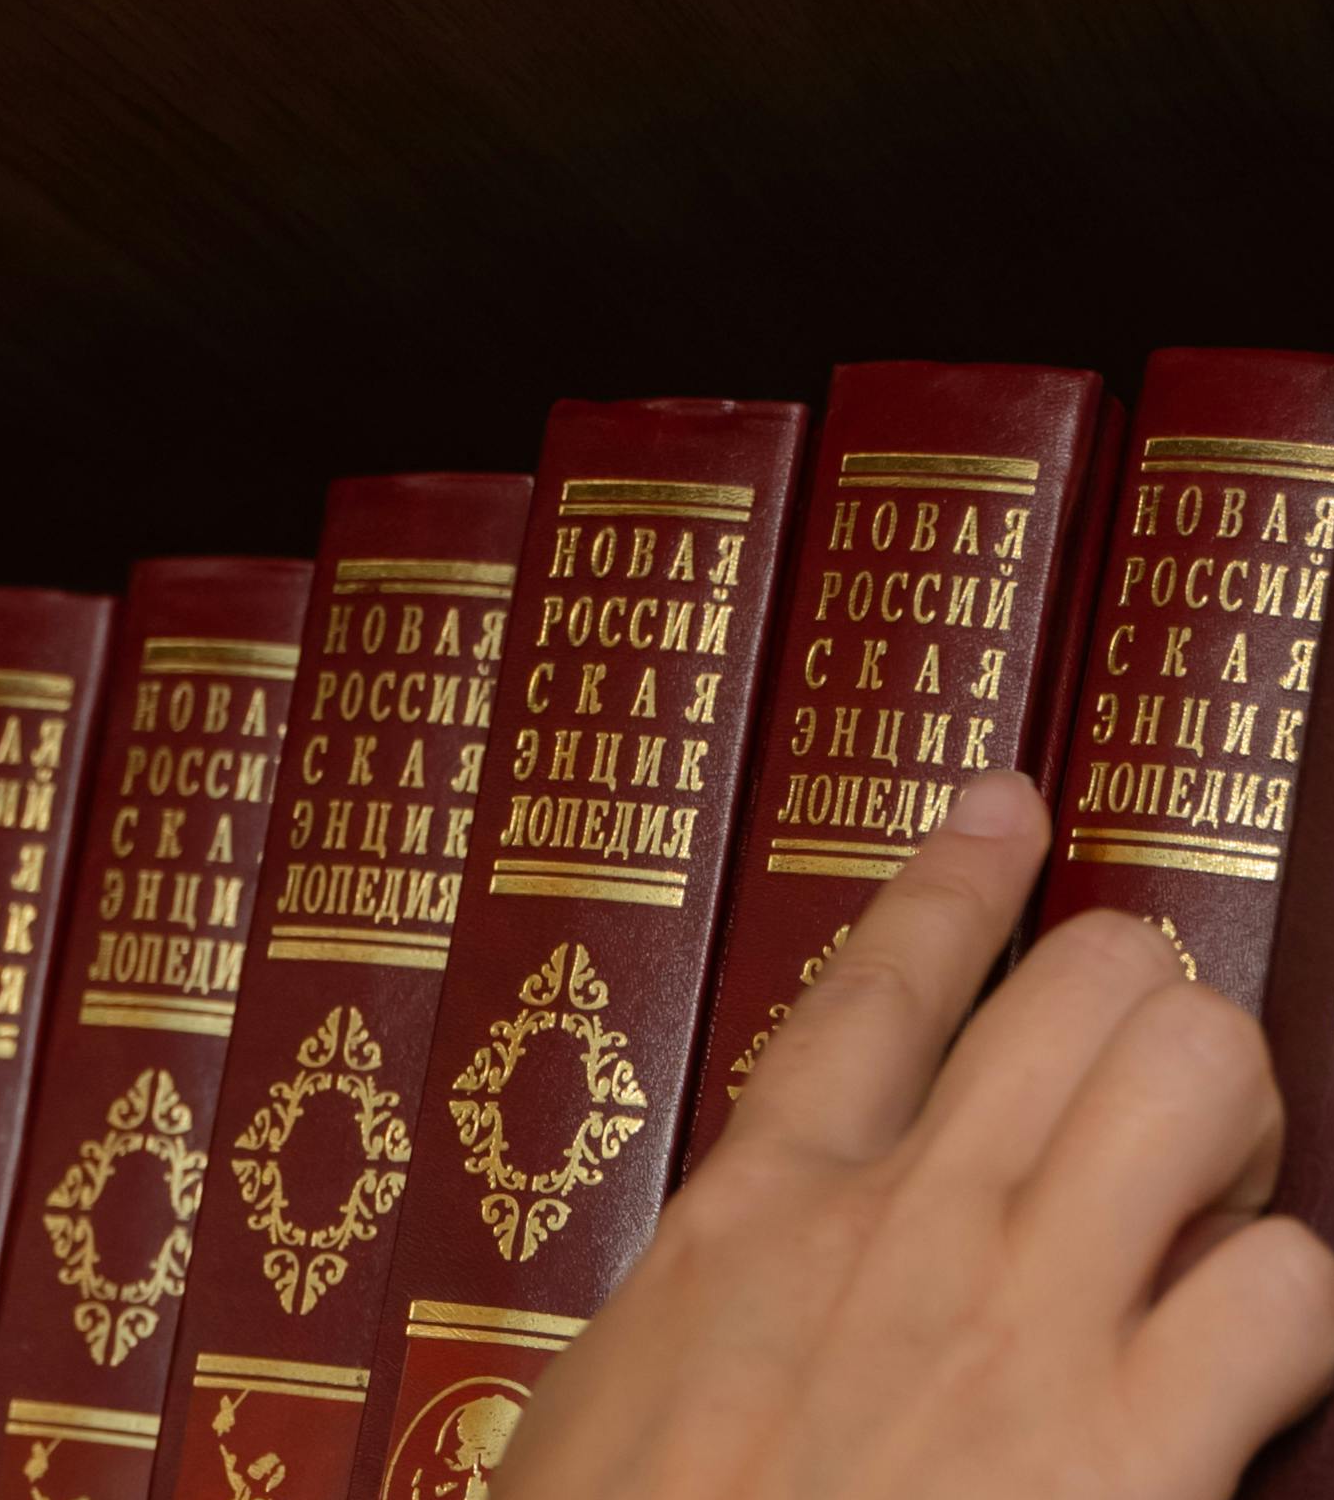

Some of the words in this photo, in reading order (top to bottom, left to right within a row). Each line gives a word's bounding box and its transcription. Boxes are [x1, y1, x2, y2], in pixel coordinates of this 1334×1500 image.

[548, 525, 745, 587] НОВАЯ
[829, 500, 1031, 561] НОВАЯ
[815, 565, 1019, 631] РОССИЙ
[1118, 552, 1329, 622] РОССИЙ
[323, 605, 507, 663] НОВАЯ
[536, 587, 733, 656] РОССИЙ
[805, 637, 1007, 701] СКАЯ
[1106, 625, 1317, 693] СКАЯ
[311, 663, 493, 729] РОССИЙ
[526, 662, 722, 725] СКАЯ
[791, 706, 994, 771] ЭНЦИК
[1092, 693, 1305, 764] ЭНЦИК
[301, 735, 485, 794] СКАЯ
[513, 729, 709, 793] ЭНЦИК
[1078, 760, 1293, 831] ЛОПЕДИЯ
[290, 800, 474, 859] ЭНЦИК
[499, 796, 698, 861] ЛОПЕДИЯ
[276, 864, 462, 926] ЛОПЕДИЯ
